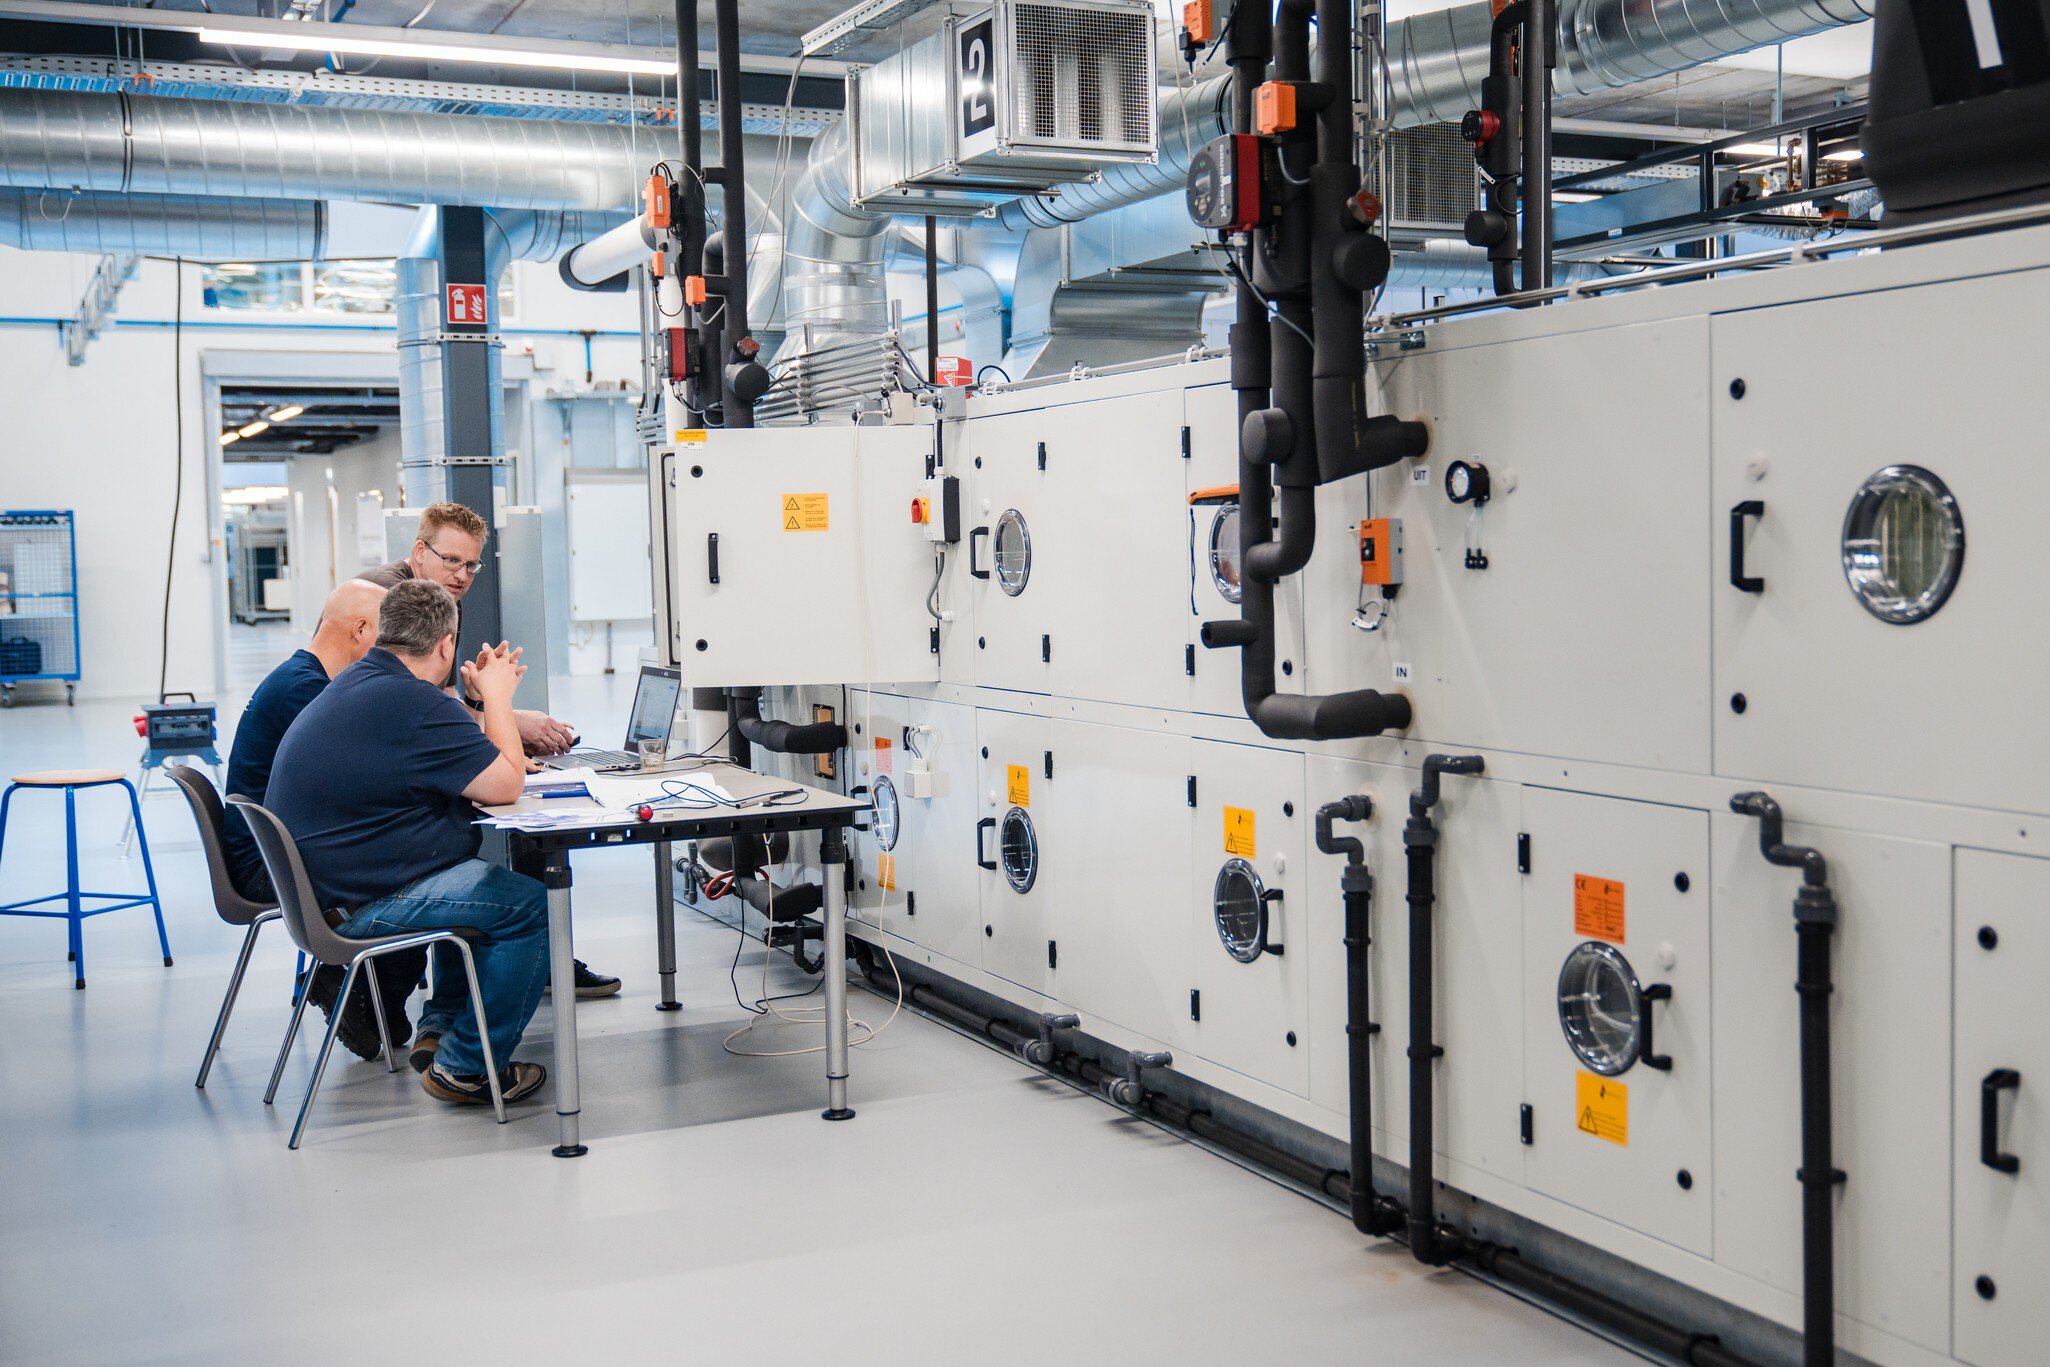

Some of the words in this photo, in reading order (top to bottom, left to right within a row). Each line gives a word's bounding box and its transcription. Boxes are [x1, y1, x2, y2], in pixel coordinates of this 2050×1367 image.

[968, 38, 987, 122] 2
[1413, 470, 1427, 481] UIT
[1396, 667, 1407, 678] IN
